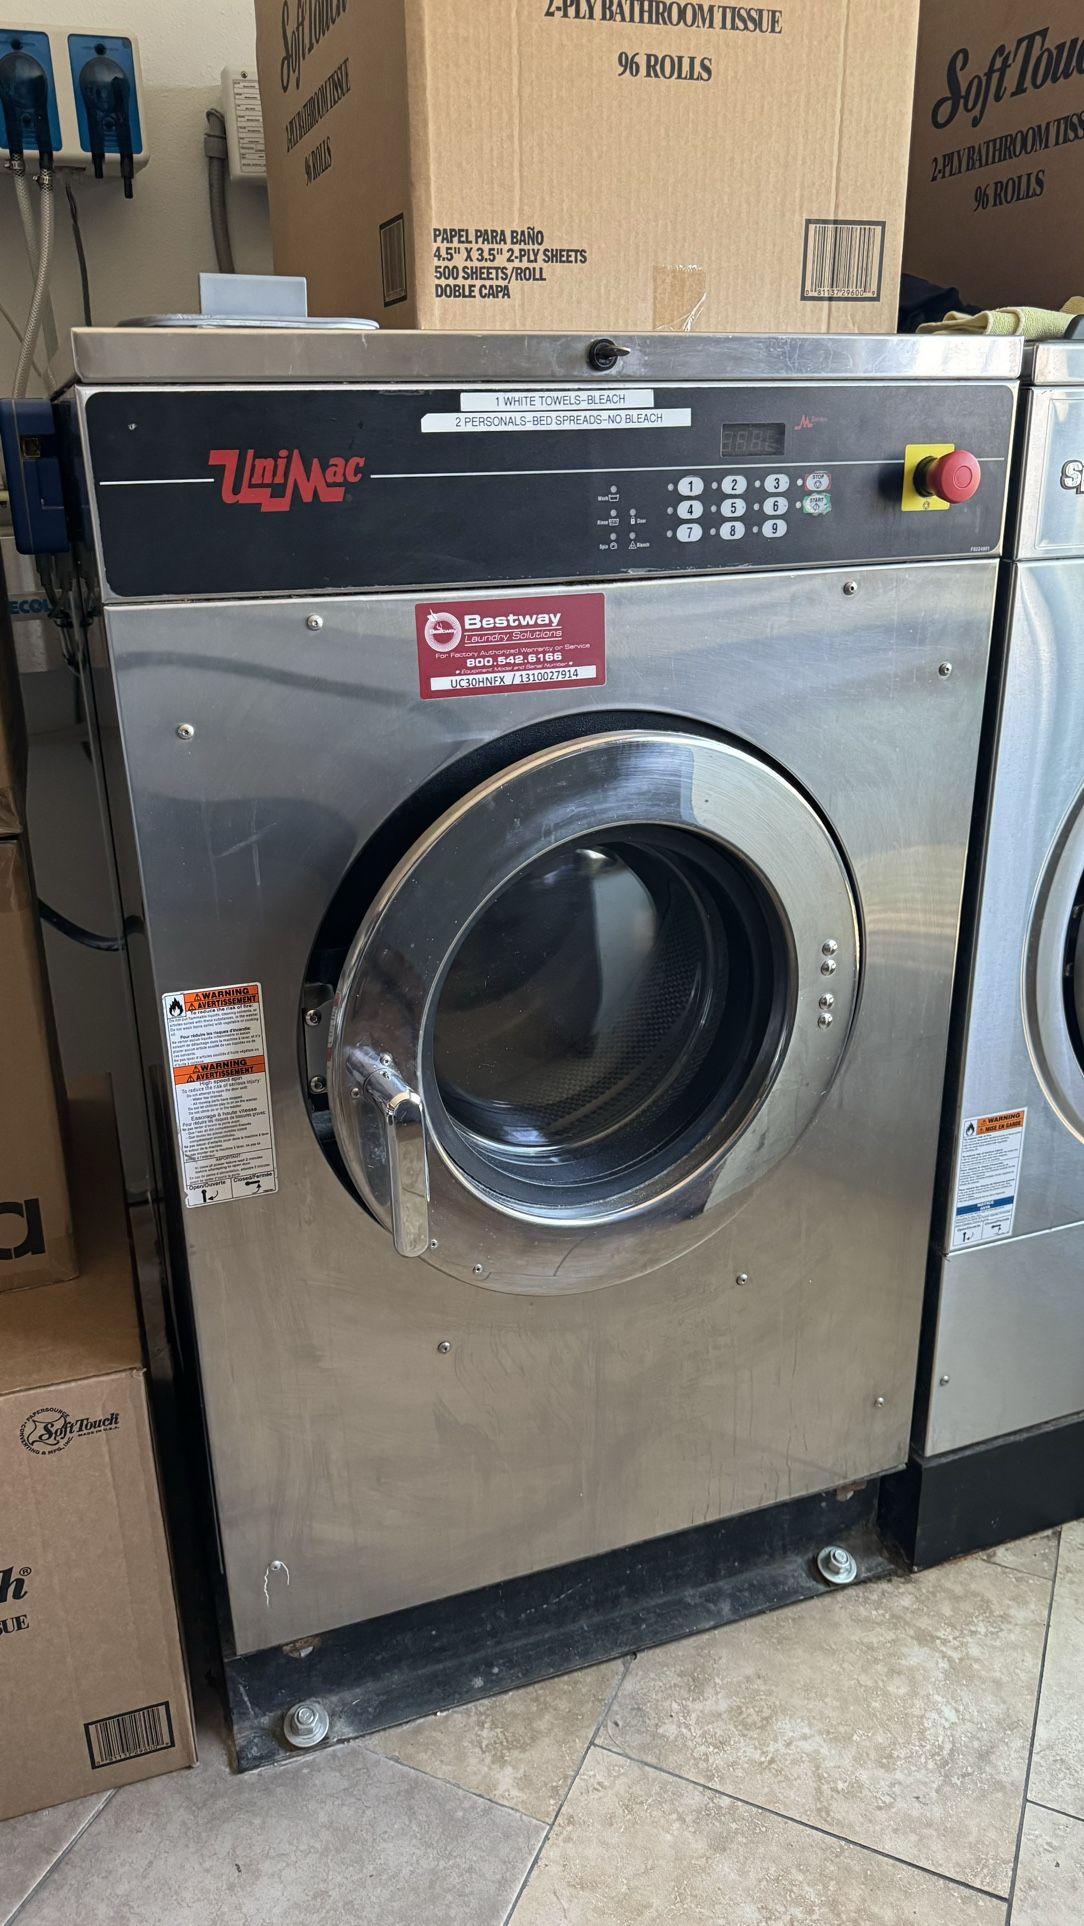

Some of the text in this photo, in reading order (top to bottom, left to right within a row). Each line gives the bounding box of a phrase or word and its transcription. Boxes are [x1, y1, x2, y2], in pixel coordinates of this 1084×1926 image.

[544, 0, 783, 34] 2-PLY BATHROOM TISSUE
[617, 51, 712, 82] 96 ROLLS
[312, 136, 332, 181] ROLLS
[930, 148, 966, 182] 2-PLY
[966, 121, 1051, 172] BATHROOM
[973, 169, 1045, 211] 96 ROLLS
[433, 226, 544, 246] PAPEL PARA BAÑO
[434, 247, 588, 264] 4.5" X 3.5" 2-PLY SHEETS
[434, 266, 547, 284] 500 SHEETS/ROLL
[435, 284, 511, 299] DOBLE CAPA
[496, 397, 500, 407] 1
[504, 396, 536, 407] WHITE
[456, 417, 462, 427] 2
[625, 413, 663, 424] BLEACH
[208, 449, 366, 512] UniMac
[688, 481, 693, 492] 1
[731, 480, 737, 491] 2
[774, 478, 780, 489] 3
[687, 504, 694, 516] 4
[731, 503, 737, 514] 5
[773, 501, 779, 512] 6
[687, 524, 778, 539] 7 8 9
[464, 613, 562, 630] Bestway
[465, 629, 563, 644] Laundry Solutions
[451, 650, 478, 659] Factory
[480, 648, 519, 656] Authorized
[520, 646, 554, 654] Warranty
[466, 653, 563, 668] 800.542.6166
[450, 675, 505, 689] UC30HNFX
[519, 668, 579, 683] 1310027914
[202, 987, 249, 1000] WARNING
[197, 995, 256, 1008] AVERTISSEMENT
[200, 1058, 247, 1071] WARNING
[195, 1066, 254, 1081] AVERTISSEMENT
[988, 1112, 1021, 1124] WARNING
[26, 1408, 70, 1422] PAPERSOURCE
[20, 1424, 40, 1455] CONVERTING
